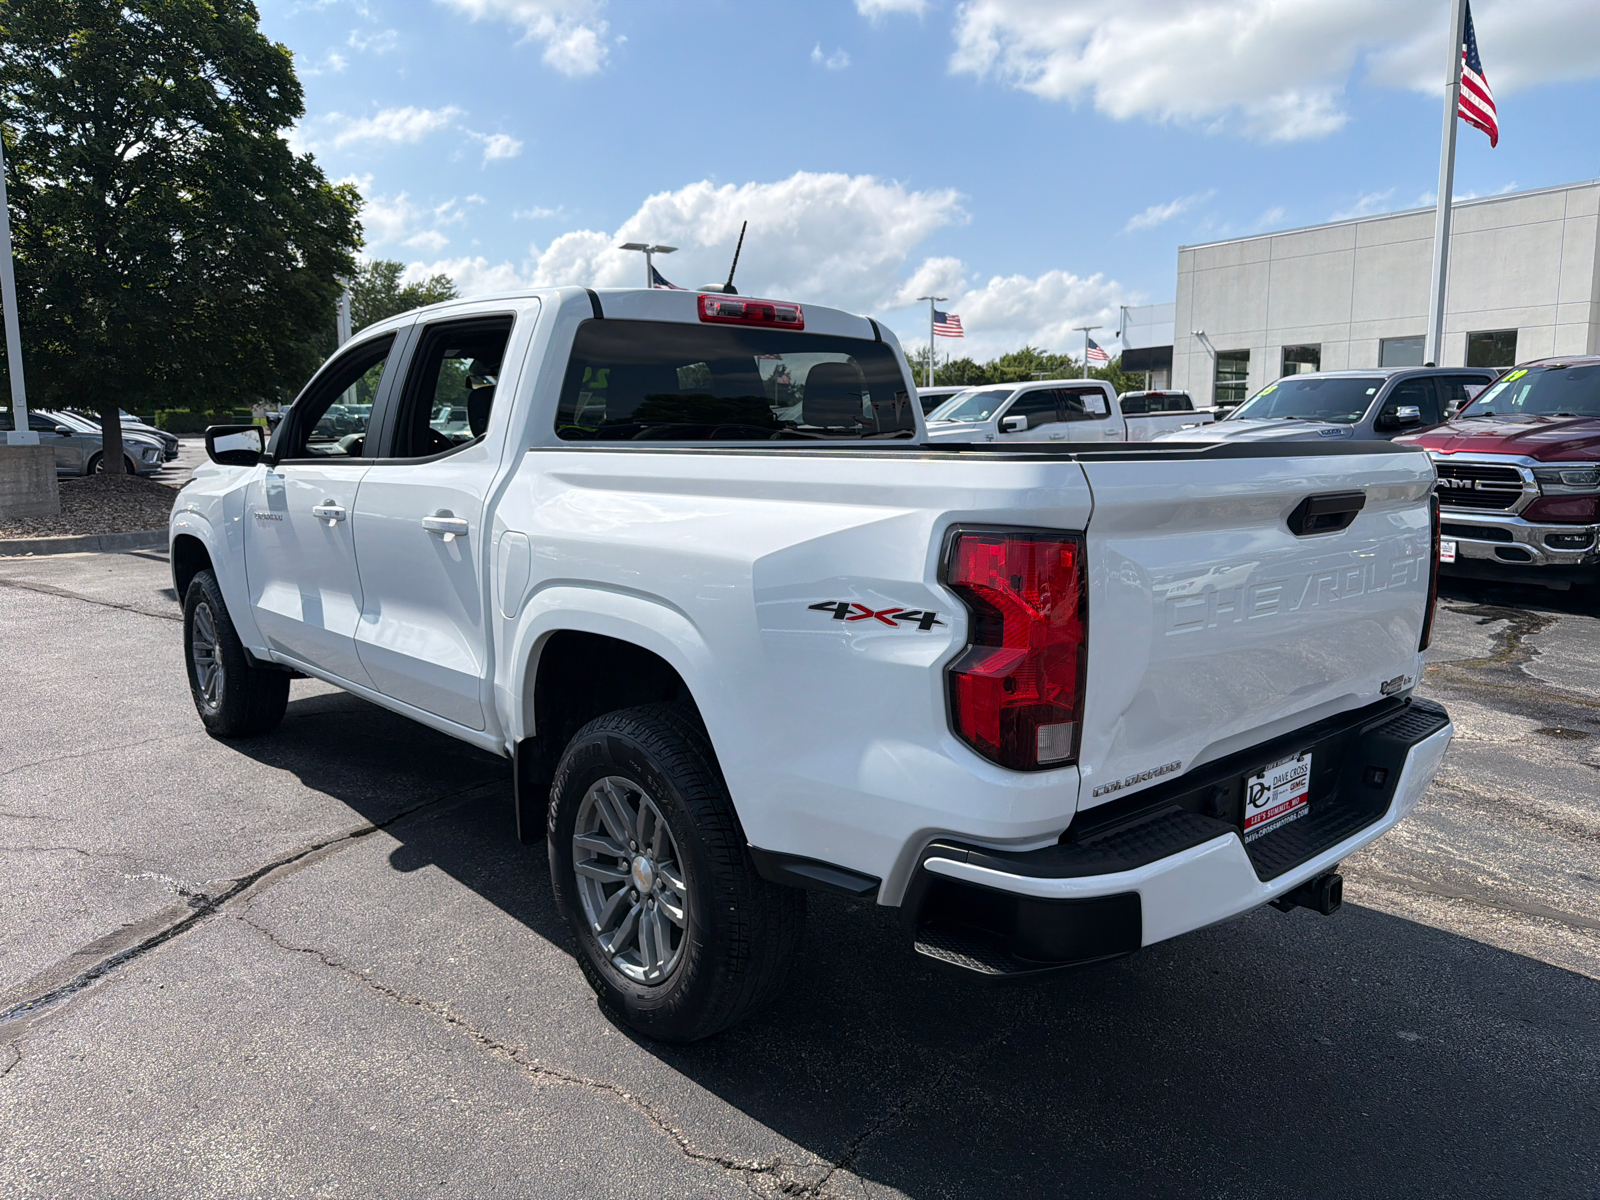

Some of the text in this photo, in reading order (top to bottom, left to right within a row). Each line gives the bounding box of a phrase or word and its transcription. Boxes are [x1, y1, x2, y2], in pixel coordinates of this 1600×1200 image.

[1165, 552, 1426, 636] CHEVROLET
[1093, 760, 1182, 797] COLORADO
[1273, 763, 1309, 786] DAVE CROSS
[1251, 811, 1267, 825] LEE'S
